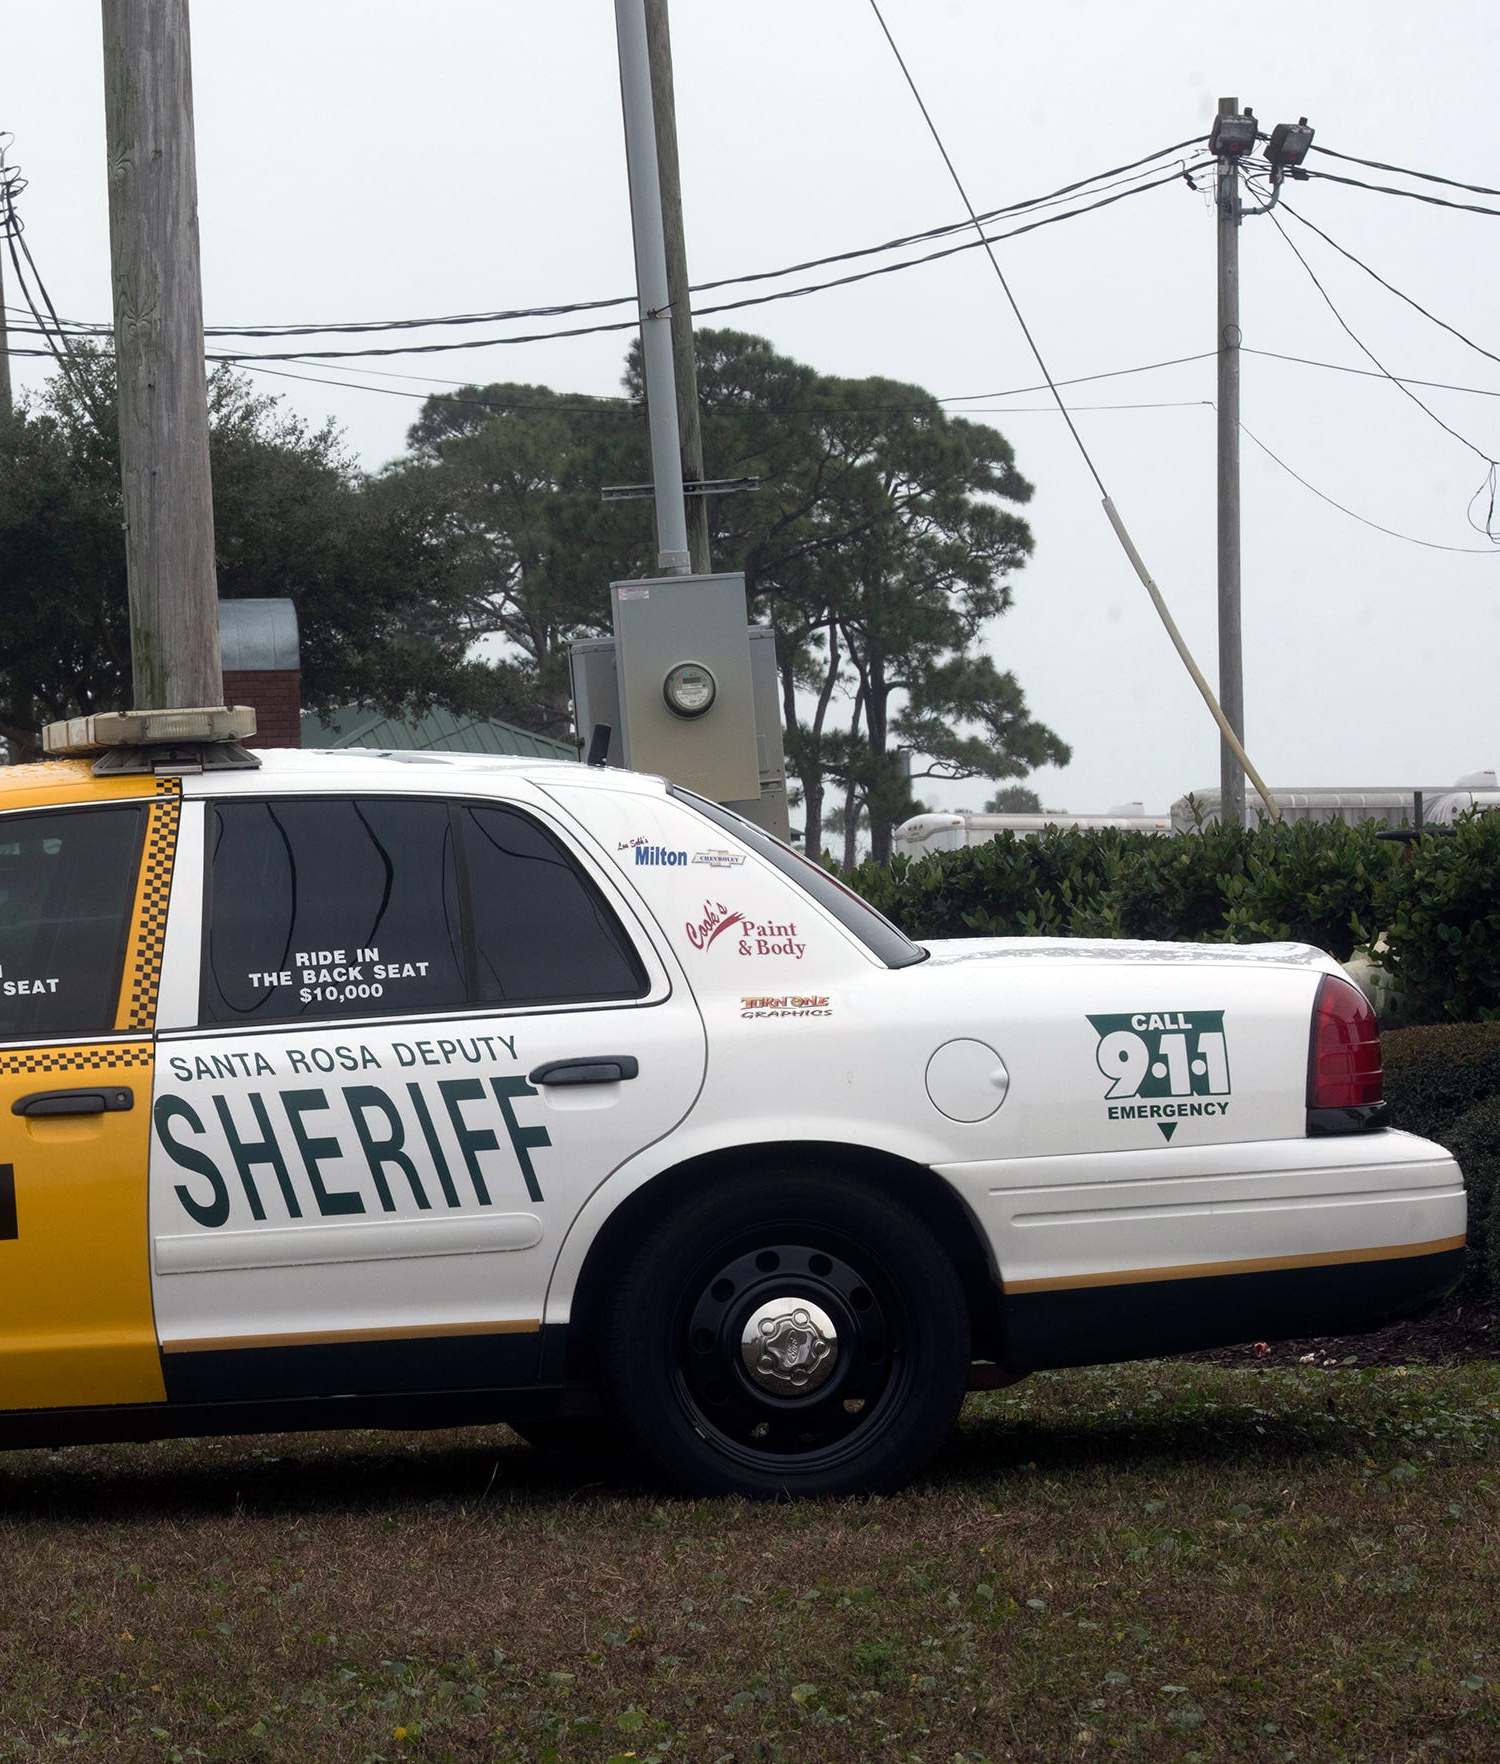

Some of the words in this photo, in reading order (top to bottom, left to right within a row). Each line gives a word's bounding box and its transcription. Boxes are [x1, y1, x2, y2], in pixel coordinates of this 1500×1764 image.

[635, 846, 687, 866] Milton
[700, 855, 739, 863] CHEVROLET
[686, 899, 728, 950] Cook's
[741, 920, 798, 937] Paint
[295, 950, 346, 967] RIDE
[356, 948, 380, 963] IN
[738, 939, 752, 956] &
[756, 938, 806, 959] Body
[248, 971, 293, 988] THE
[302, 966, 363, 984] BACK
[373, 962, 429, 980] SEAT
[3, 978, 59, 996] SEAT
[299, 983, 383, 1003] $10,000
[740, 996, 788, 1009] TURN
[790, 995, 830, 1007] ONE
[740, 1009, 833, 1019] GRAPHICS
[1131, 1013, 1192, 1031] CALL
[169, 1052, 277, 1082] SANTA
[286, 1045, 382, 1074] ROSA
[391, 1035, 519, 1067] DEPUTY
[1107, 1102, 1229, 1120] EMERGENCY
[153, 1074, 552, 1228] SHERIFF
